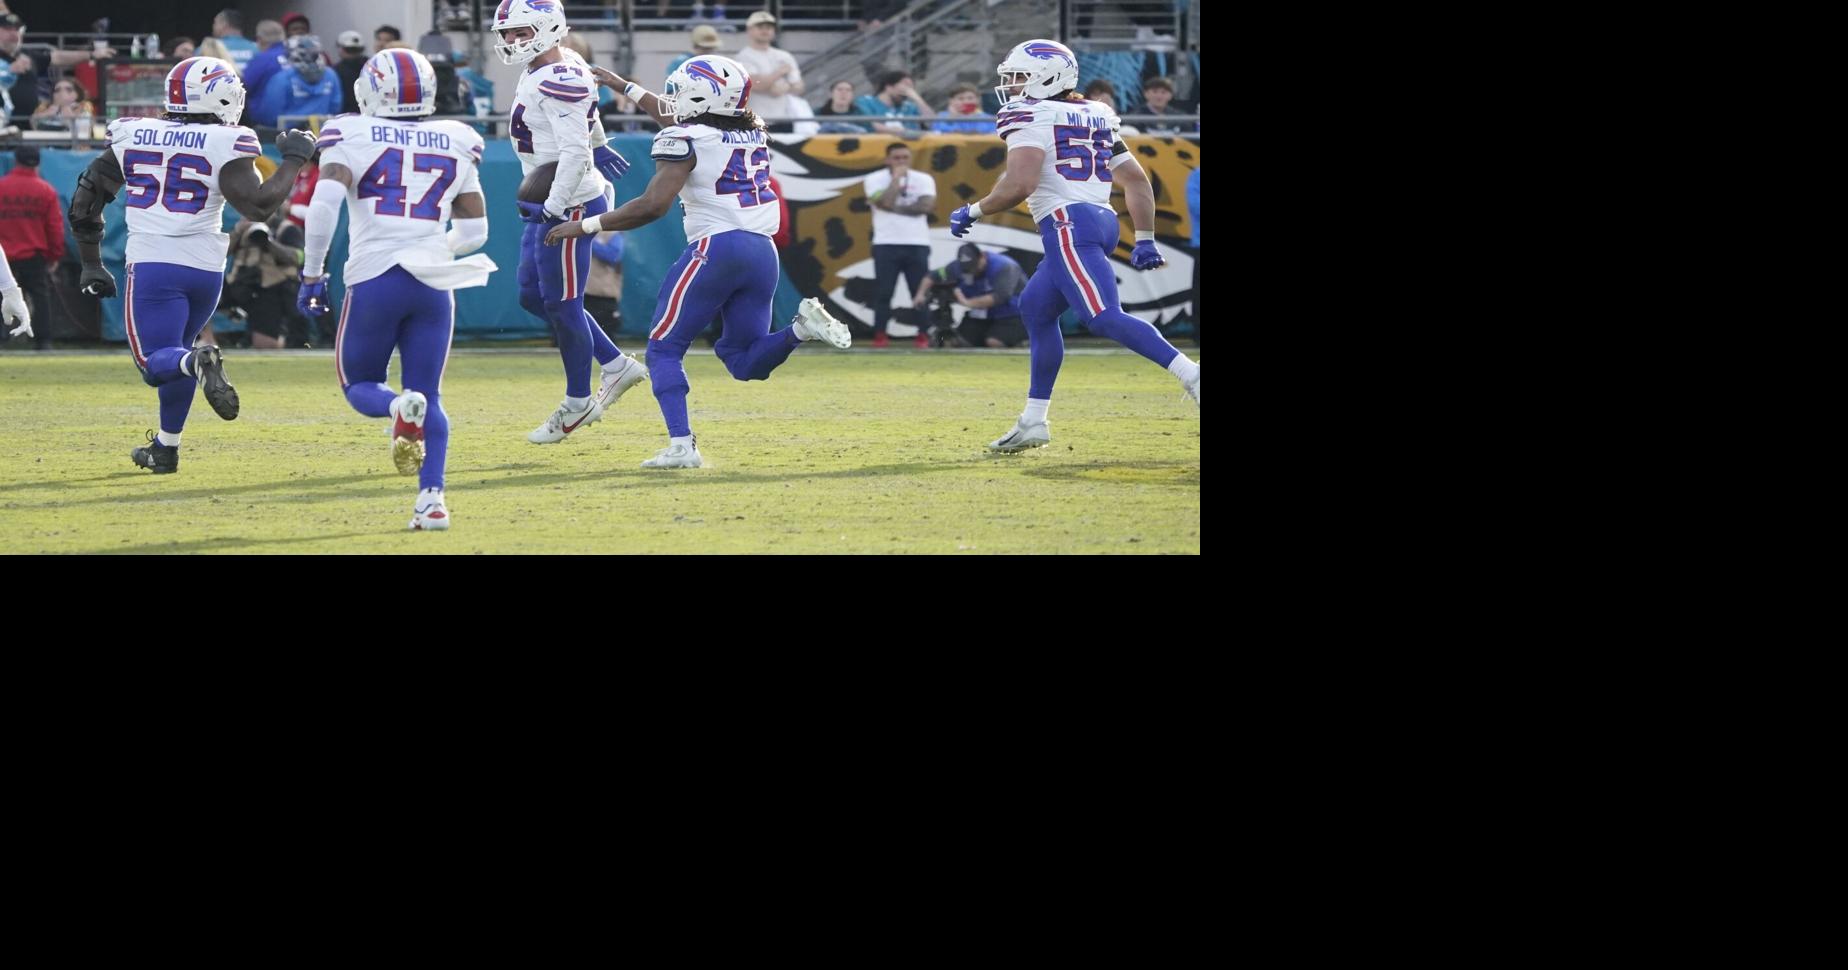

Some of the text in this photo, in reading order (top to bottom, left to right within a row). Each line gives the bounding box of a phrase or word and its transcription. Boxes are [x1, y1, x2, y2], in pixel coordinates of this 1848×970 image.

[133, 128, 207, 149] SOLOMON
[371, 126, 450, 150] BENFORD
[123, 149, 212, 215] 56
[357, 147, 458, 222] 47
[715, 147, 778, 209] 42
